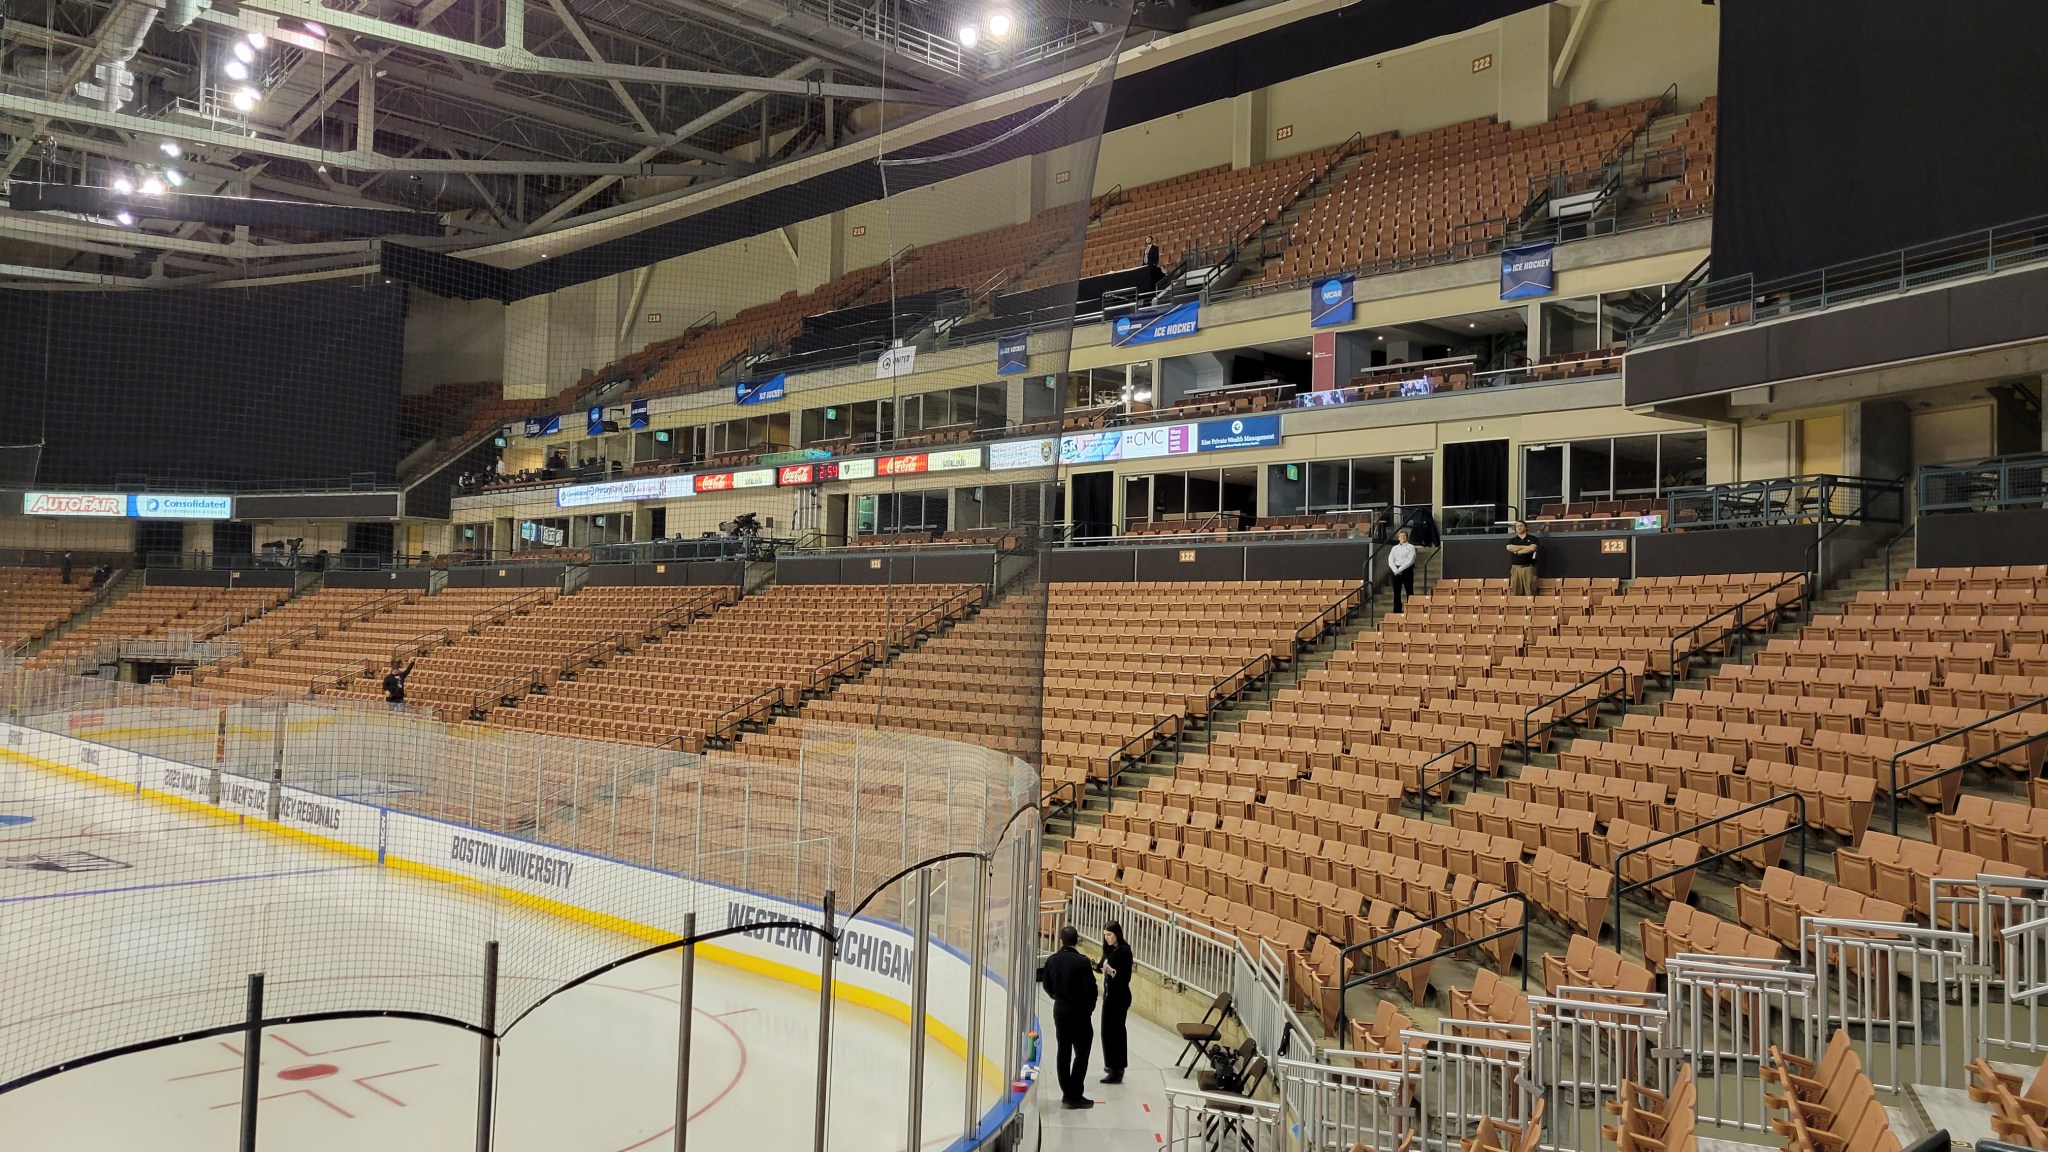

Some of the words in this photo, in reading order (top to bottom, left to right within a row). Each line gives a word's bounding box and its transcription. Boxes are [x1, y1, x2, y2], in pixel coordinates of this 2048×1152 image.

[1473, 57, 1490, 71] 222
[1277, 127, 1292, 139] 221
[1056, 172, 1069, 182] 220
[853, 227, 865, 236] 219
[1512, 263, 1524, 272] ICE
[1523, 258, 1551, 270] HOCKEY
[1323, 289, 1342, 300] NCAA
[1153, 326, 1167, 338] ICE
[1166, 320, 1197, 336] HOCKEY
[1134, 429, 1164, 447] CMC
[1243, 433, 1275, 442] Management
[886, 455, 919, 474] Coca-Cola
[782, 465, 810, 484] Coca-Cola
[624, 482, 637, 496] ally
[702, 475, 727, 490] Coca-Cola
[31, 495, 121, 514] AUTOFAIR
[164, 499, 226, 509] Consolidated
[1603, 541, 1624, 552] 123
[1181, 552, 1195, 561] 122
[181, 772, 197, 793] NCAA
[296, 799, 341, 831] REGIONALS
[451, 835, 498, 870] BOSTON
[499, 846, 574, 889] UNIVERSITY
[727, 901, 815, 955] WESTERN
